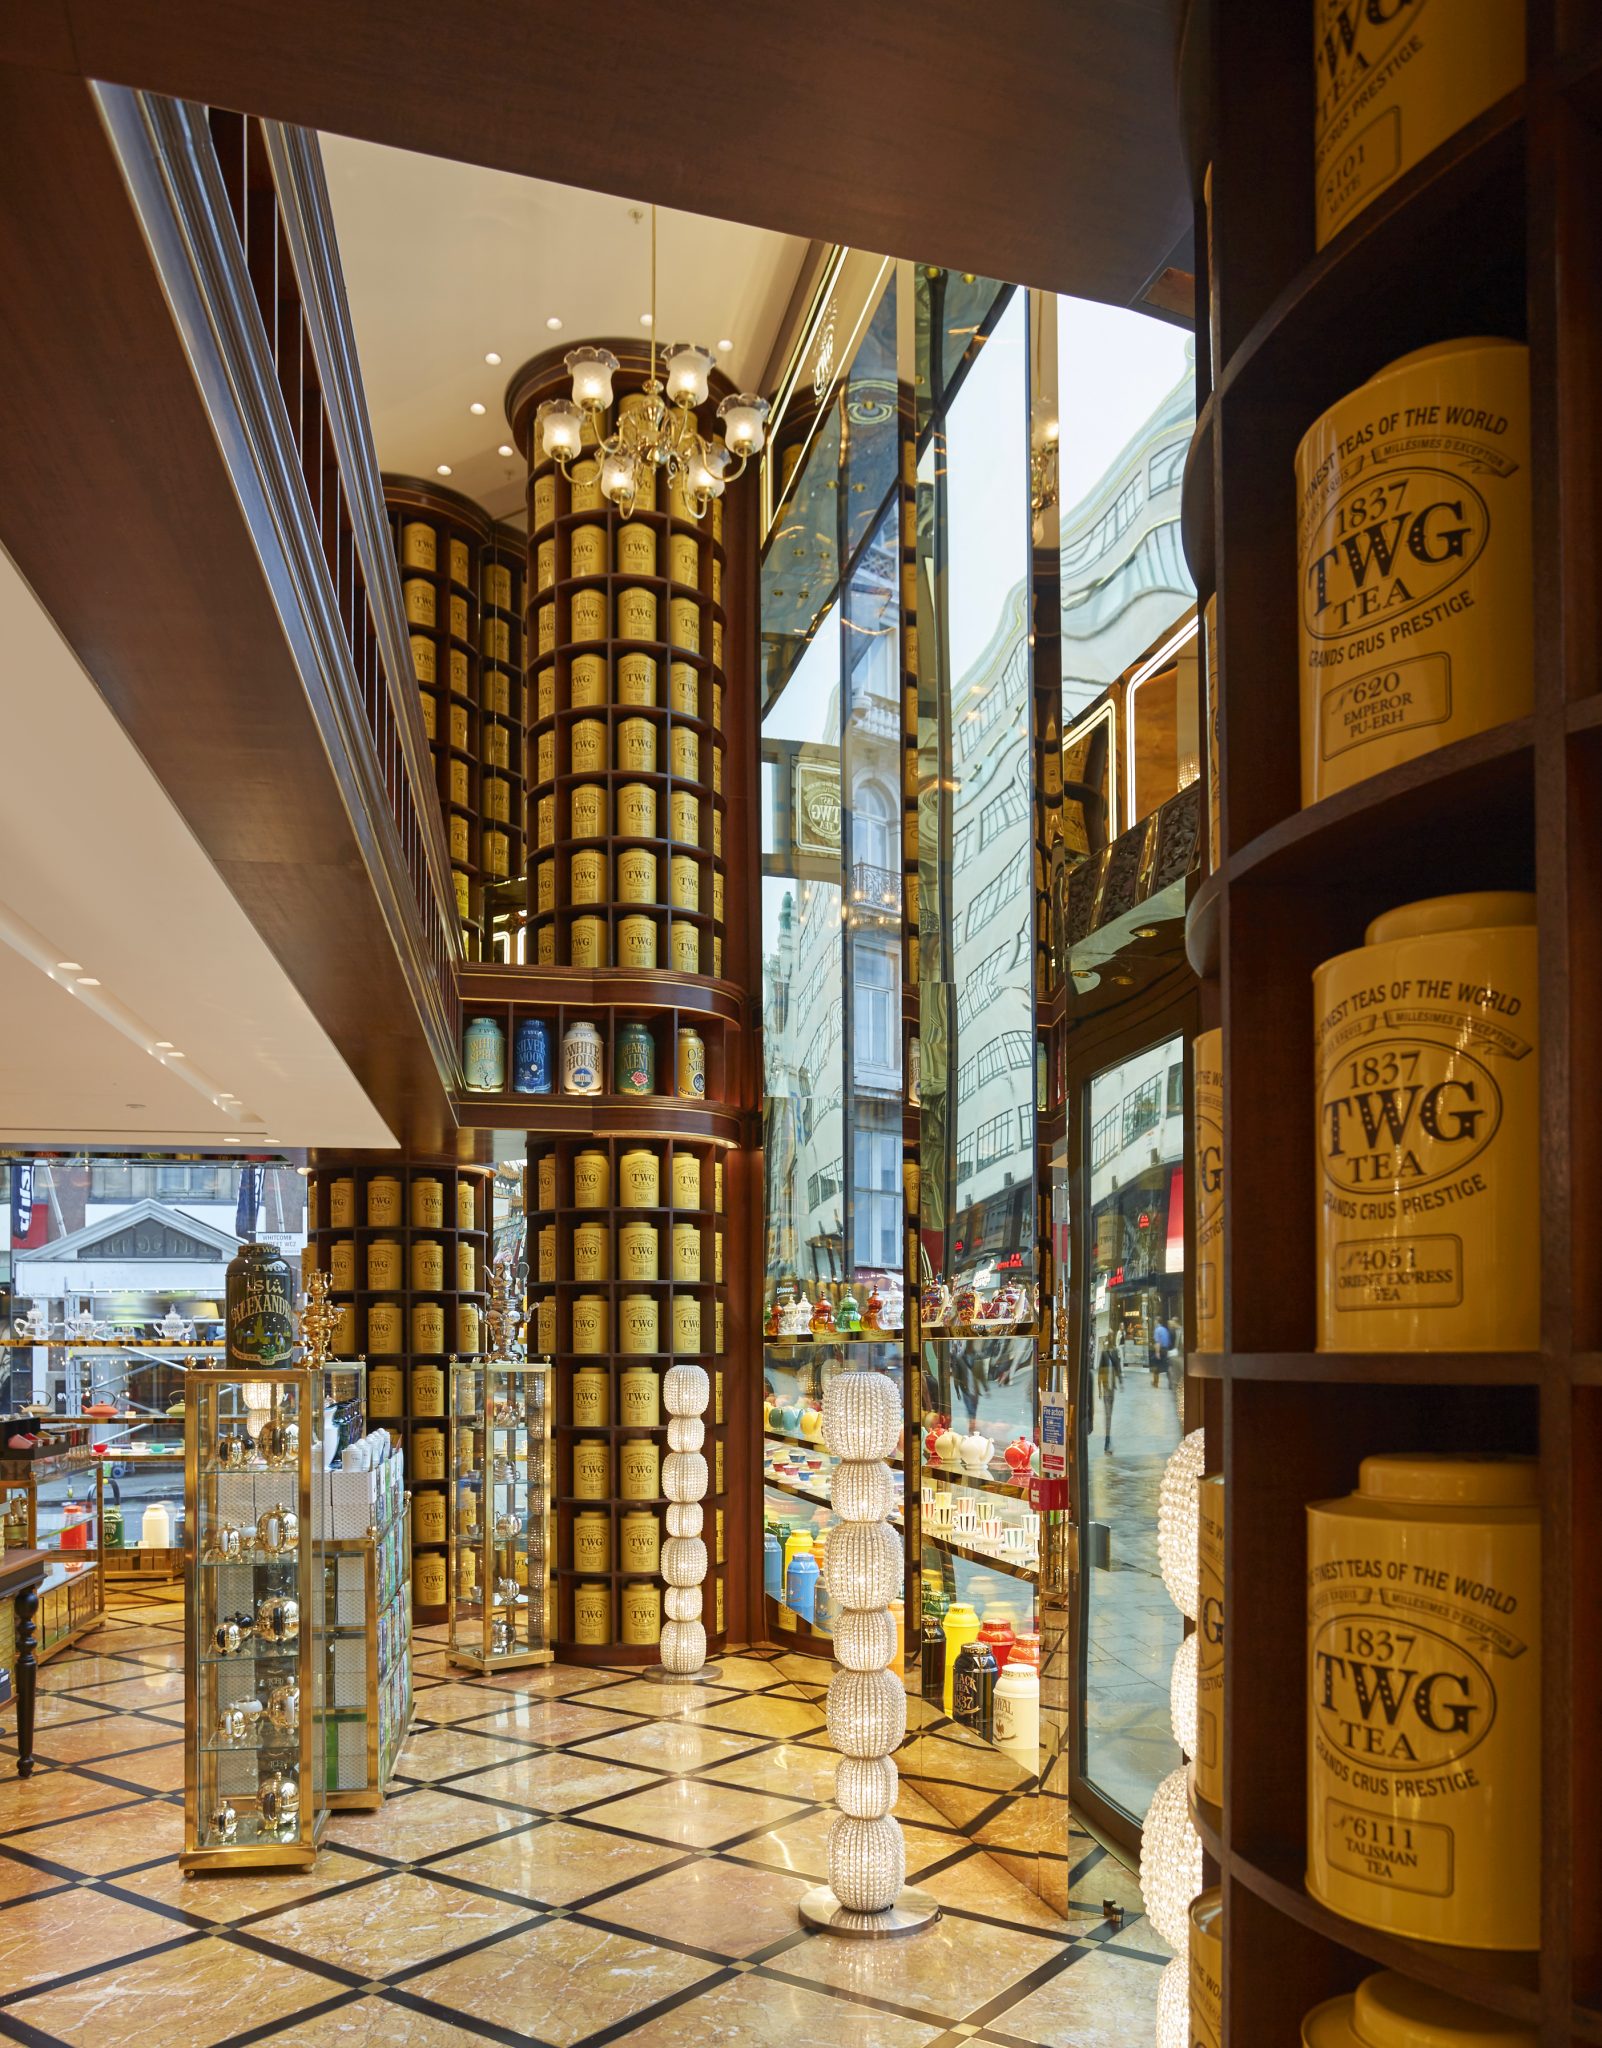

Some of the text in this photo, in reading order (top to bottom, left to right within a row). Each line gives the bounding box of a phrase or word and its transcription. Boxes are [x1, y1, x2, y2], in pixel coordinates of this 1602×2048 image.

[1351, 34, 1424, 118] PRESTIGE
[1337, 423, 1374, 459] TEAS
[1378, 412, 1399, 435] OF
[1404, 406, 1440, 427] THE
[1445, 406, 1508, 435] WORLD
[1337, 479, 1410, 538] 1837
[626, 543, 649, 553] TWG
[1308, 501, 1472, 617] TWG
[1333, 577, 1415, 630] TEA
[577, 609, 598, 619] TWG
[629, 608, 651, 618] TWG
[1347, 631, 1385, 660] CRUS
[1390, 589, 1475, 643] PRESTIGE
[625, 674, 650, 683] TWG
[1343, 692, 1413, 727] EMPEROR
[1349, 709, 1404, 738] PU-ERH
[574, 740, 596, 750] TWG
[628, 739, 651, 748] TWG
[574, 806, 596, 814] TWG
[629, 804, 652, 814] TWG
[574, 871, 596, 880] TWG
[627, 871, 650, 880] TWG
[629, 937, 652, 946] TWG
[1351, 984, 1386, 1011] TEAS
[1390, 981, 1411, 1000] OF
[1416, 979, 1452, 1000] THE
[1457, 982, 1522, 1016] WORLD
[566, 1041, 600, 1058] WHITE
[566, 1055, 600, 1074] HOUSE
[1350, 1050, 1421, 1089] 1837
[1323, 1080, 1485, 1157] TWG
[1347, 1150, 1426, 1184] TEA
[576, 1174, 597, 1183] TWG
[632, 1173, 654, 1182] TWG
[371, 1197, 391, 1205] TWG
[1360, 1201, 1396, 1220] CRUS
[1402, 1173, 1487, 1215] PRESTIGE
[576, 1247, 597, 1255] TWG
[630, 1246, 653, 1255] TWG
[1387, 1269, 1453, 1285] EXPRESS
[574, 1319, 595, 1327] TWG
[631, 1319, 654, 1328] TWG
[371, 1387, 391, 1395] TWG
[417, 1387, 438, 1395] TWG
[576, 1391, 597, 1400] TWG
[627, 1391, 650, 1400] TWG
[581, 1465, 604, 1473] TWG
[629, 1465, 652, 1473] TWG
[580, 1538, 603, 1546] TWG
[630, 1538, 654, 1546] TWG
[423, 1575, 443, 1583] TWG
[1347, 1559, 1383, 1578] TEAS
[1387, 1562, 1408, 1581] OF
[1413, 1566, 1449, 1591] THE
[1454, 1576, 1517, 1615] WORLD
[580, 1610, 603, 1618] TWG
[632, 1610, 655, 1618] TWG
[1344, 1626, 1416, 1665] 1837
[1316, 1650, 1479, 1735] TWG
[1339, 1719, 1419, 1762] TEA
[1352, 1770, 1389, 1797] CRUS
[1395, 1768, 1480, 1797] PRESTIGE
[1345, 1837, 1418, 1868] TALISMAN
[1364, 1858, 1393, 1879] TEA
